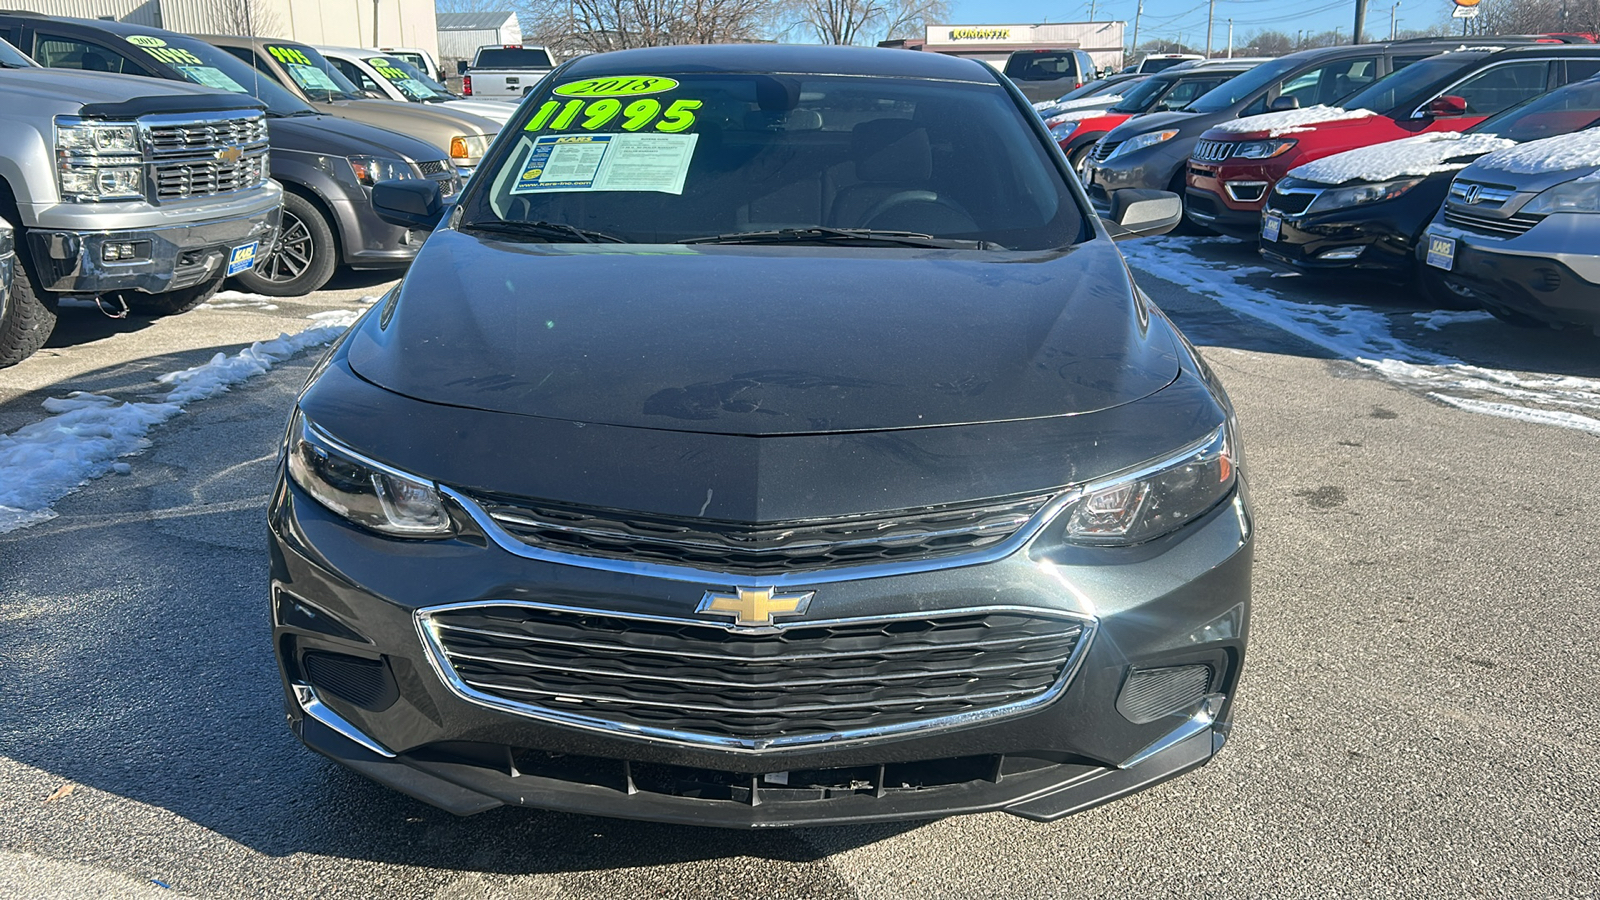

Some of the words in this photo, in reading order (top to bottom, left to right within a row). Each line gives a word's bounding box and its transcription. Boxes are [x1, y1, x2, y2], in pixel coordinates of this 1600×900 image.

[951, 29, 1010, 39] ROMANTIX
[141, 47, 203, 65] 11995
[268, 46, 312, 66] 9995
[375, 66, 410, 79] 8995
[571, 78, 660, 94] 2018
[524, 98, 704, 133] 11995
[234, 246, 254, 261] KARS
[1433, 240, 1451, 254] KARS
